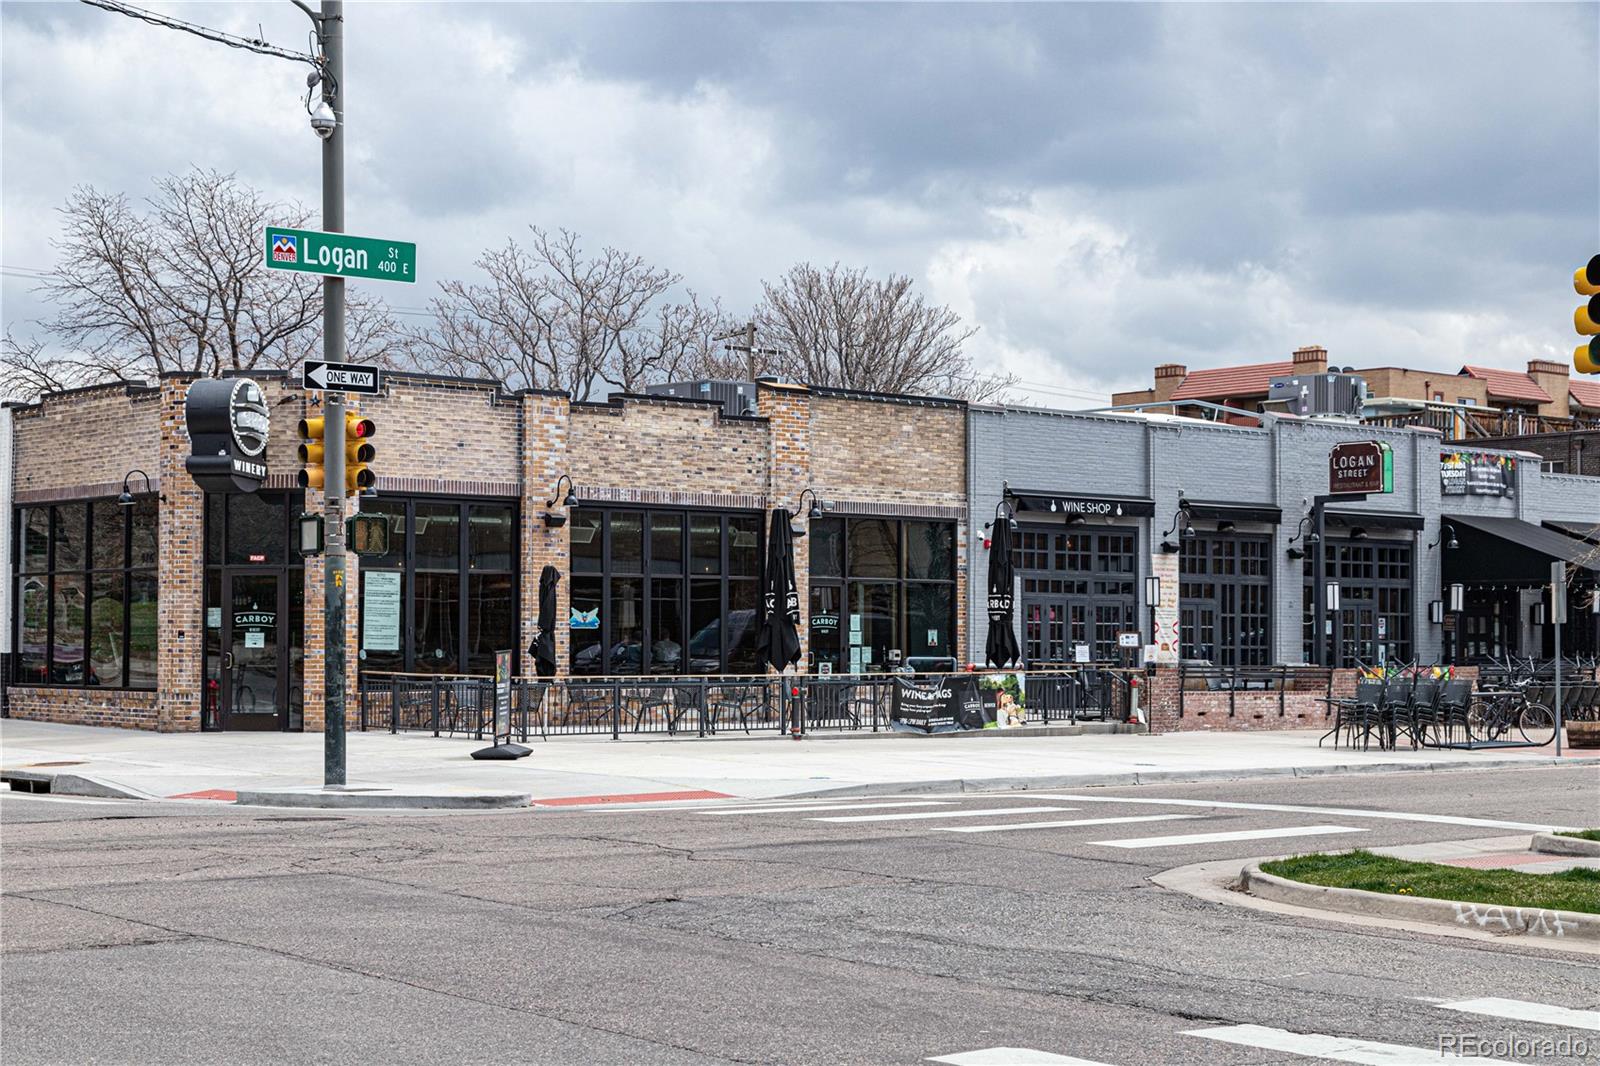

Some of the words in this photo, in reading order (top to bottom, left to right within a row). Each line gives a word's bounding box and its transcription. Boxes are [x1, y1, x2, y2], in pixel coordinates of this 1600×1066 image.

[273, 252, 297, 262] DENVER
[303, 237, 368, 273] Logan
[388, 247, 399, 260] St
[378, 260, 397, 273] 400
[402, 263, 409, 275] E
[326, 370, 347, 383] ONE
[350, 372, 371, 385] WAY
[233, 459, 267, 477] WINERY
[1332, 455, 1375, 469] LOGAN
[1337, 468, 1368, 479] STREET
[1062, 501, 1086, 513] WINE
[1086, 502, 1111, 514] SHOP
[235, 615, 275, 624] CARBOY
[811, 618, 838, 626] CARBOY
